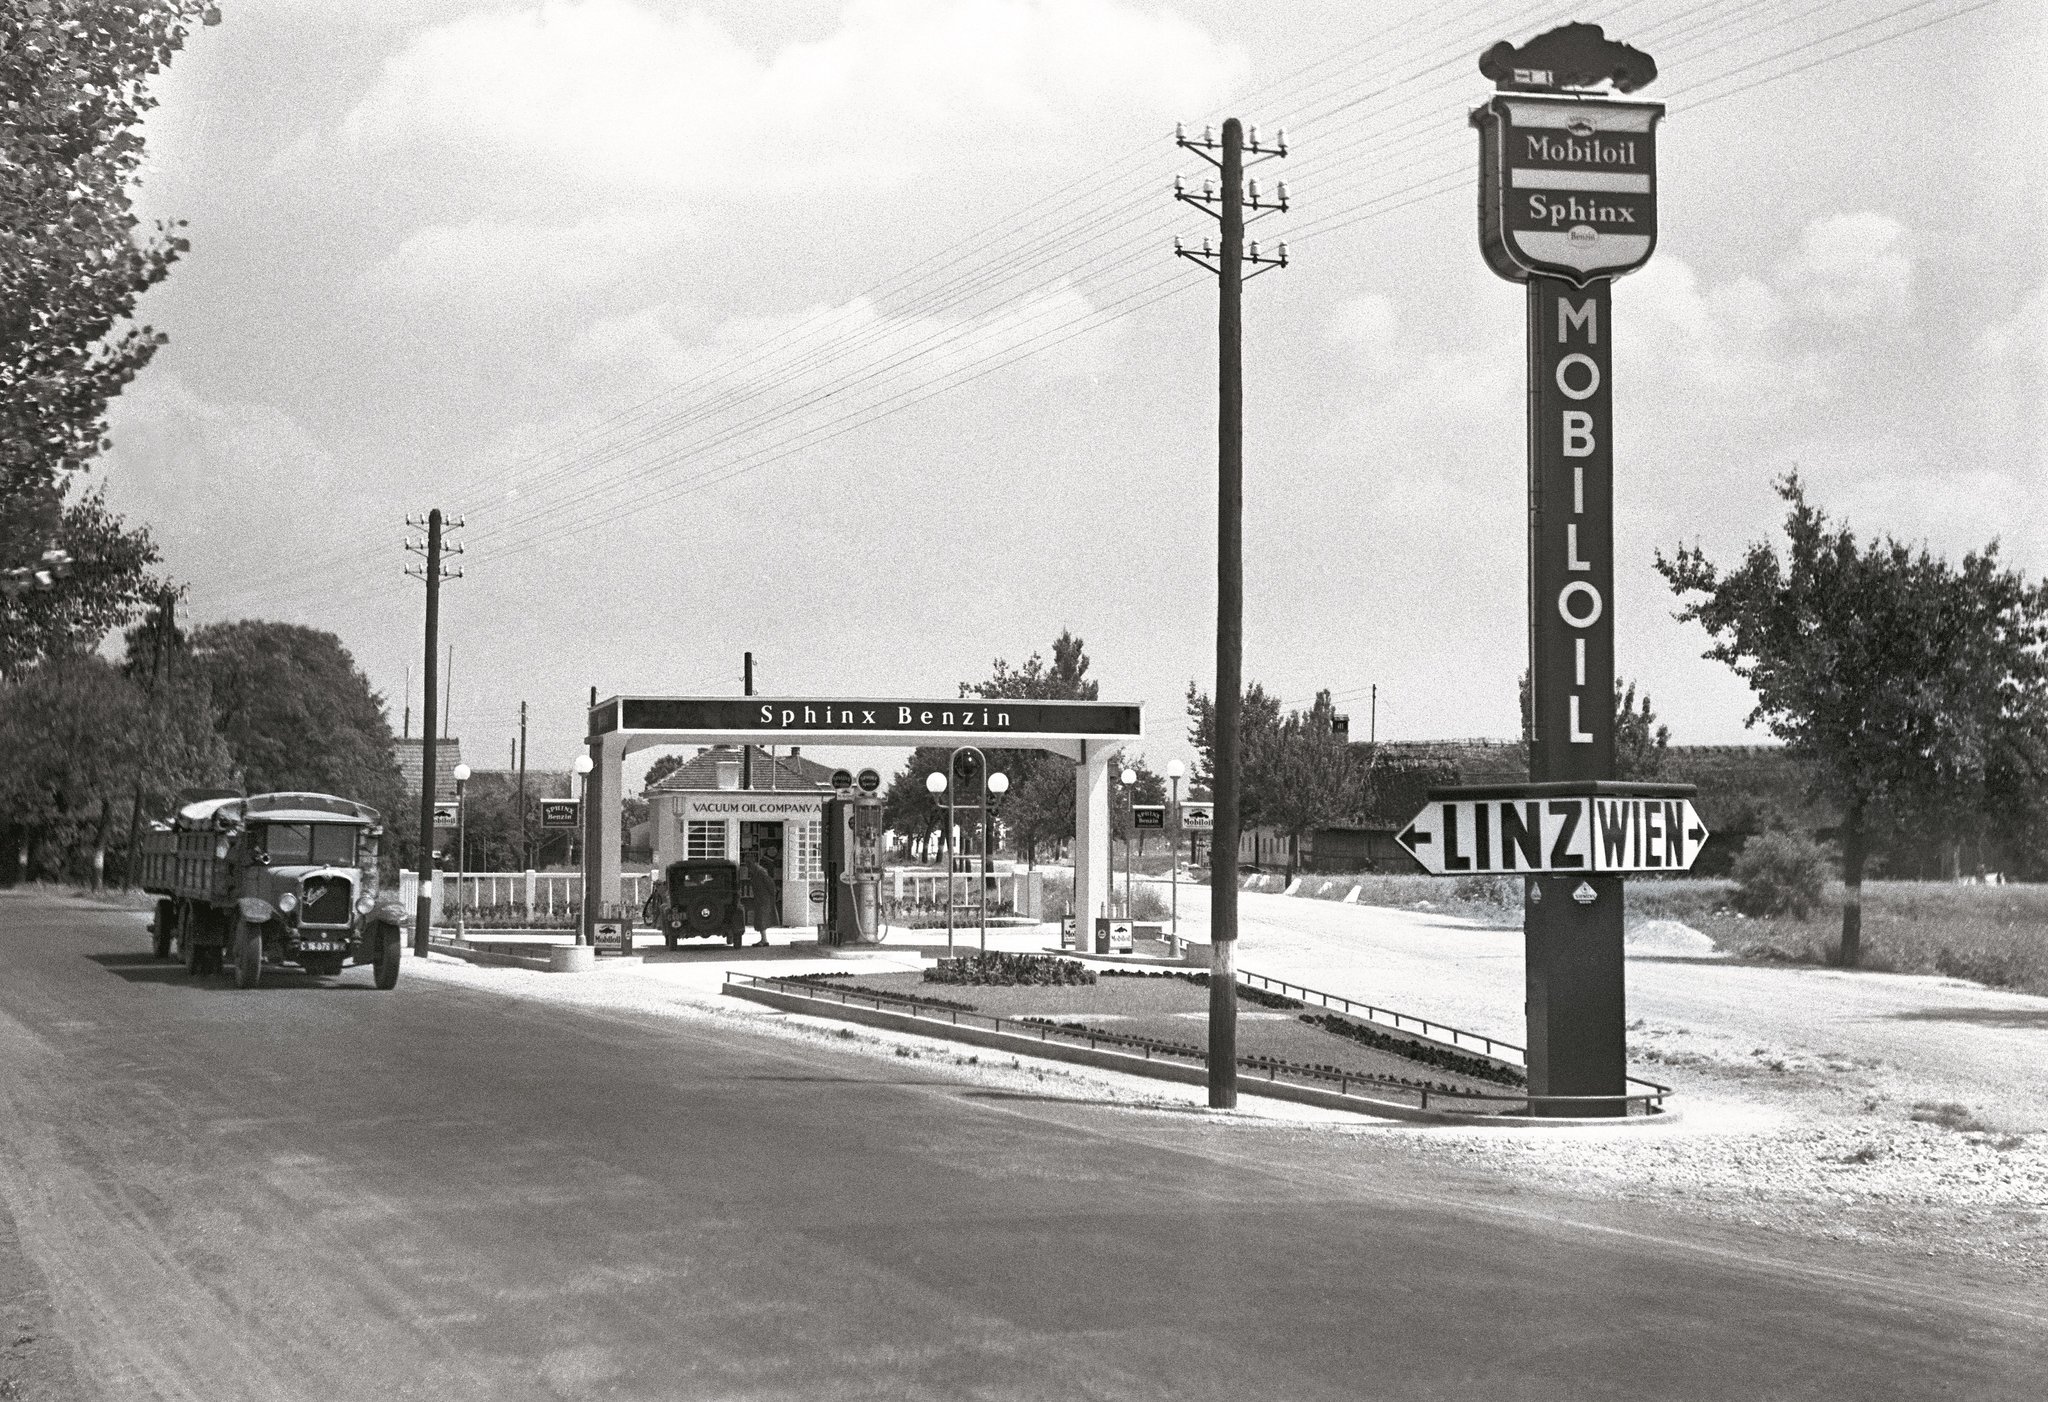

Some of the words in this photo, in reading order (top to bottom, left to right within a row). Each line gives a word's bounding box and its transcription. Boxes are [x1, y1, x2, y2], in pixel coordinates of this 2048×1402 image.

[1527, 136, 1636, 164] Mobiloil
[1529, 194, 1636, 226] Sphinx
[1555, 297, 1603, 744] MOBILOIL
[760, 705, 876, 728] Sphinx
[898, 706, 1011, 727] Benzin
[545, 805, 574, 815] SPHINX
[693, 803, 739, 813] VACUUM
[741, 803, 757, 813] OIL
[759, 804, 812, 814] COMPANY
[1443, 801, 1584, 870] LINZ
[1597, 800, 1684, 868] WIEN
[595, 935, 621, 944] Mobiloil
